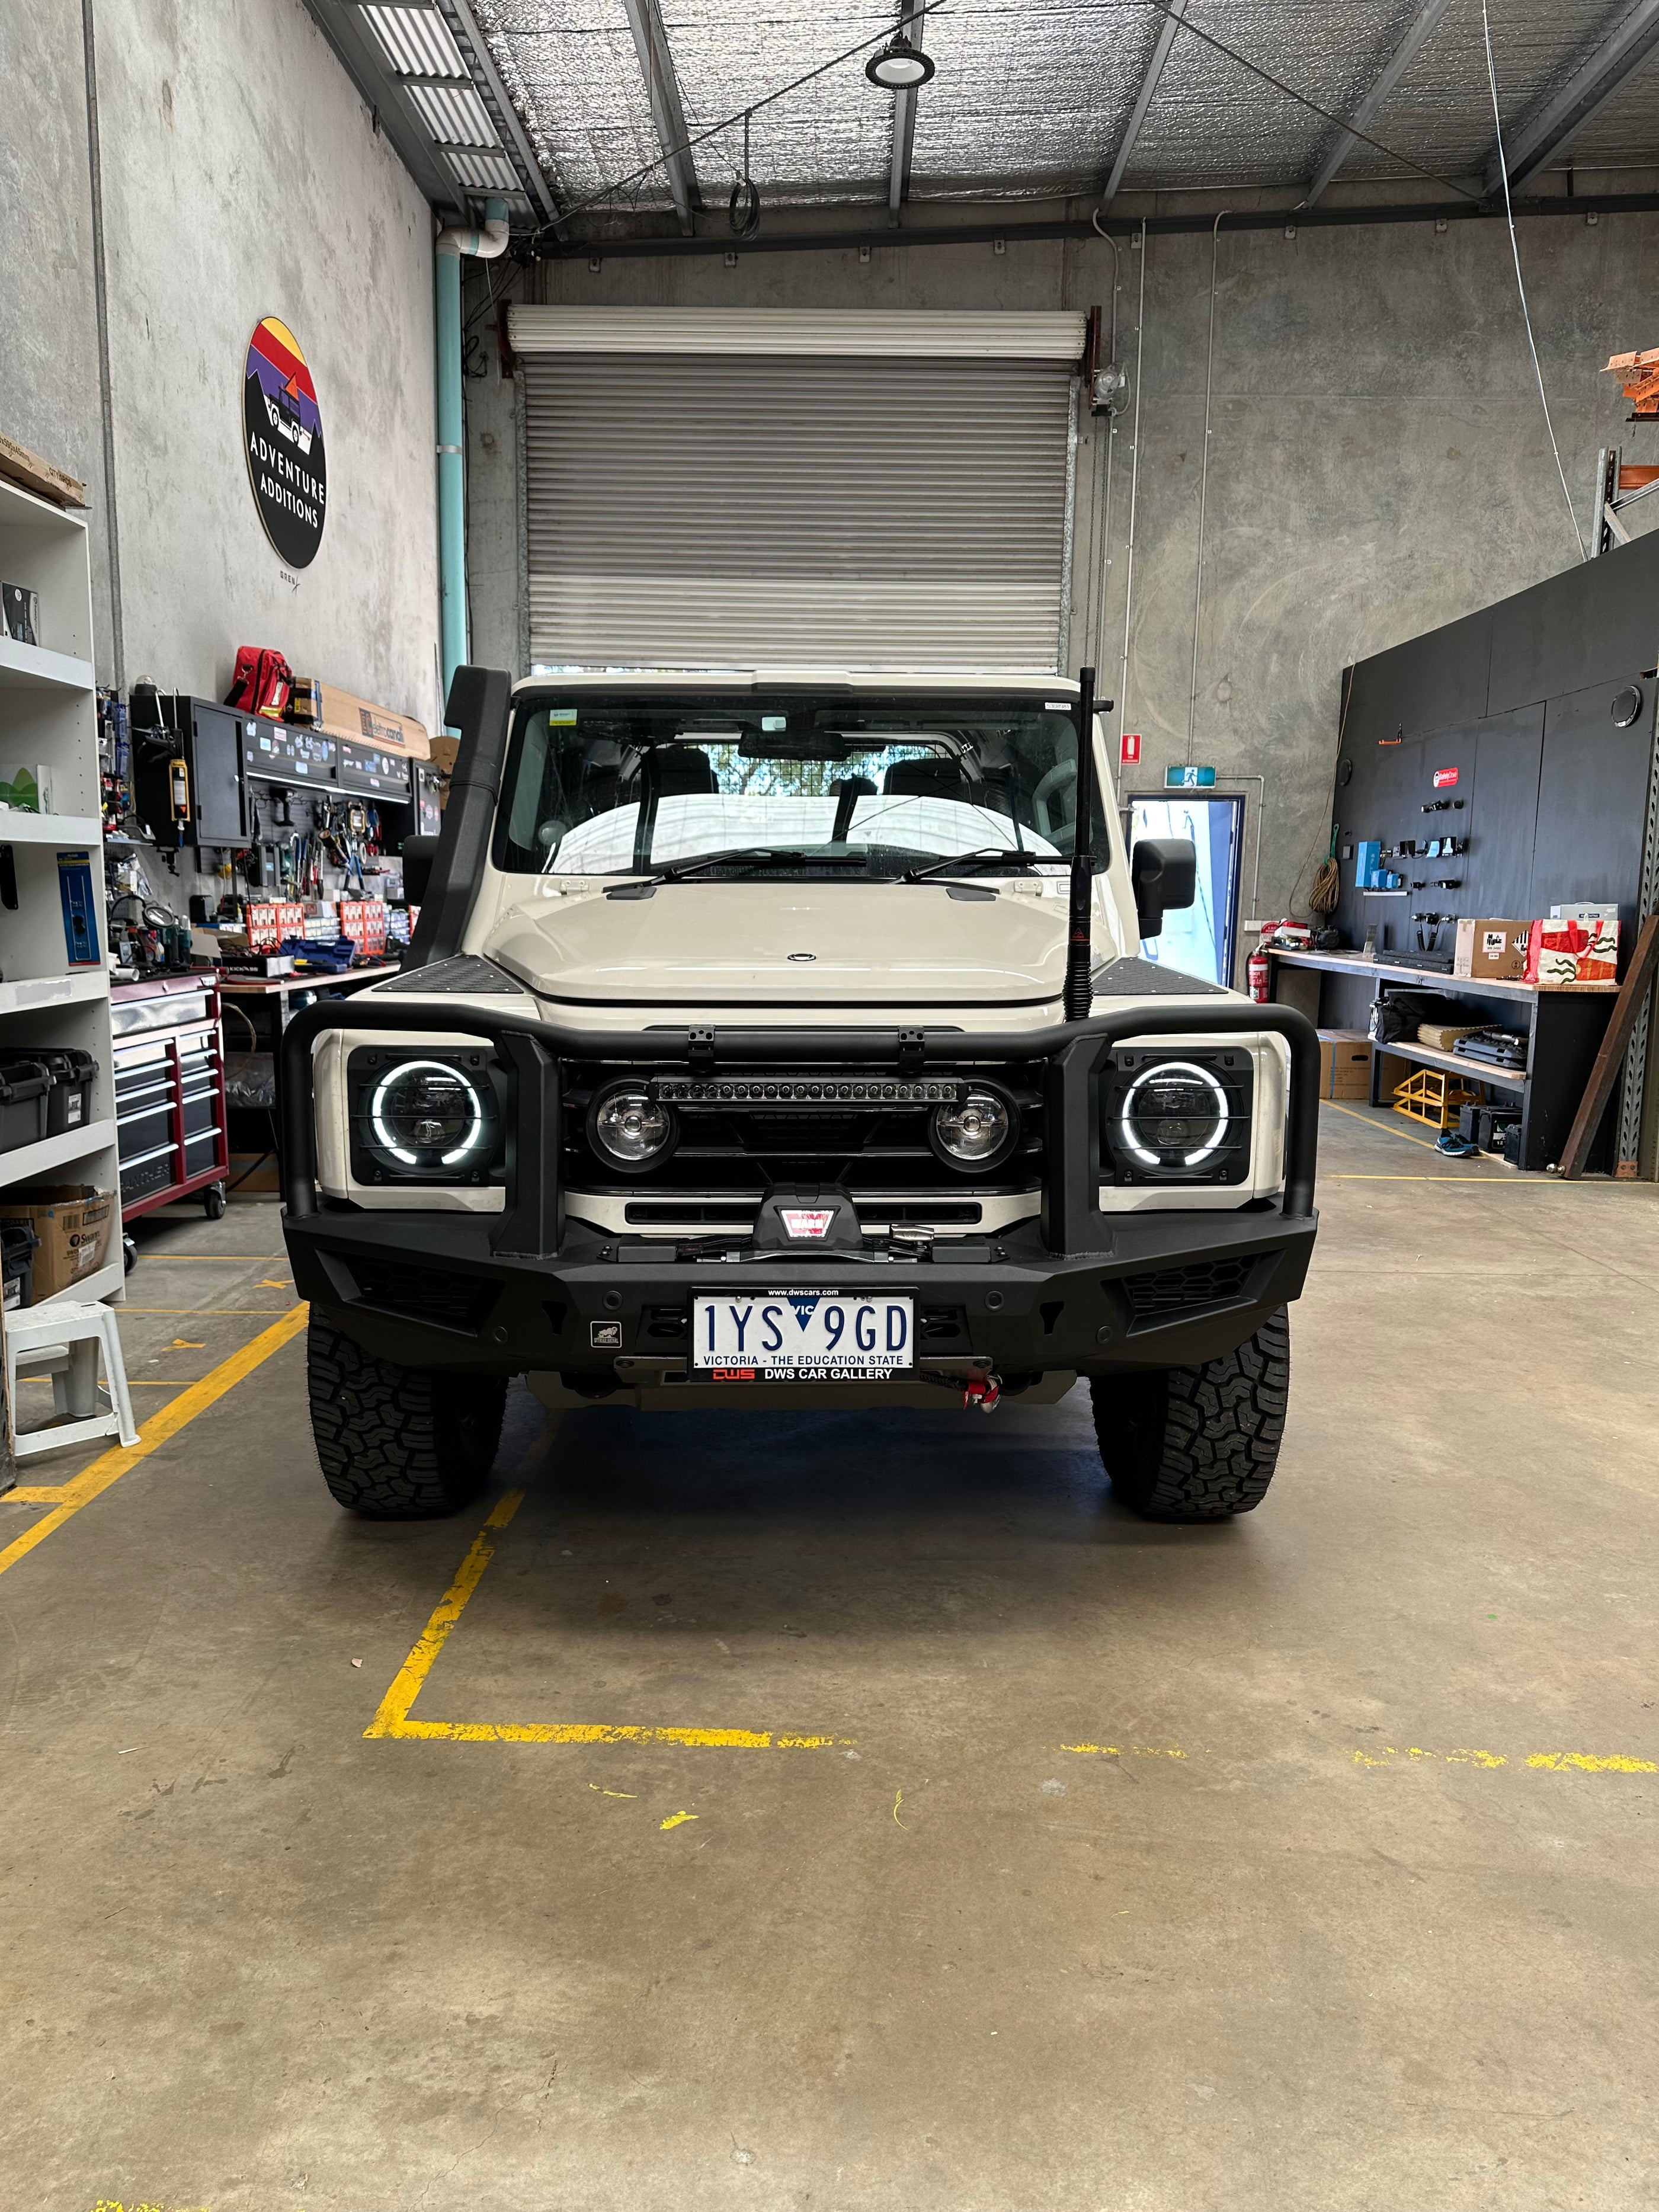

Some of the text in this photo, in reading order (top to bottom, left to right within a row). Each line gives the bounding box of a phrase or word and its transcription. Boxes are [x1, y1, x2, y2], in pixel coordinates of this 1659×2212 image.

[251, 431, 325, 505] ADVENTURE
[260, 473, 318, 529] ADDITIONS
[791, 1218, 824, 1228] WARN
[791, 1305, 814, 1315] VIC
[705, 1305, 907, 1352] 1YS 9GD
[704, 1356, 758, 1365] VICTORIA
[771, 1356, 793, 1365] THE
[798, 1356, 864, 1365] EDUCATION
[869, 1356, 903, 1365] STATE
[765, 1368, 893, 1379] DWS CAR GALLERY
